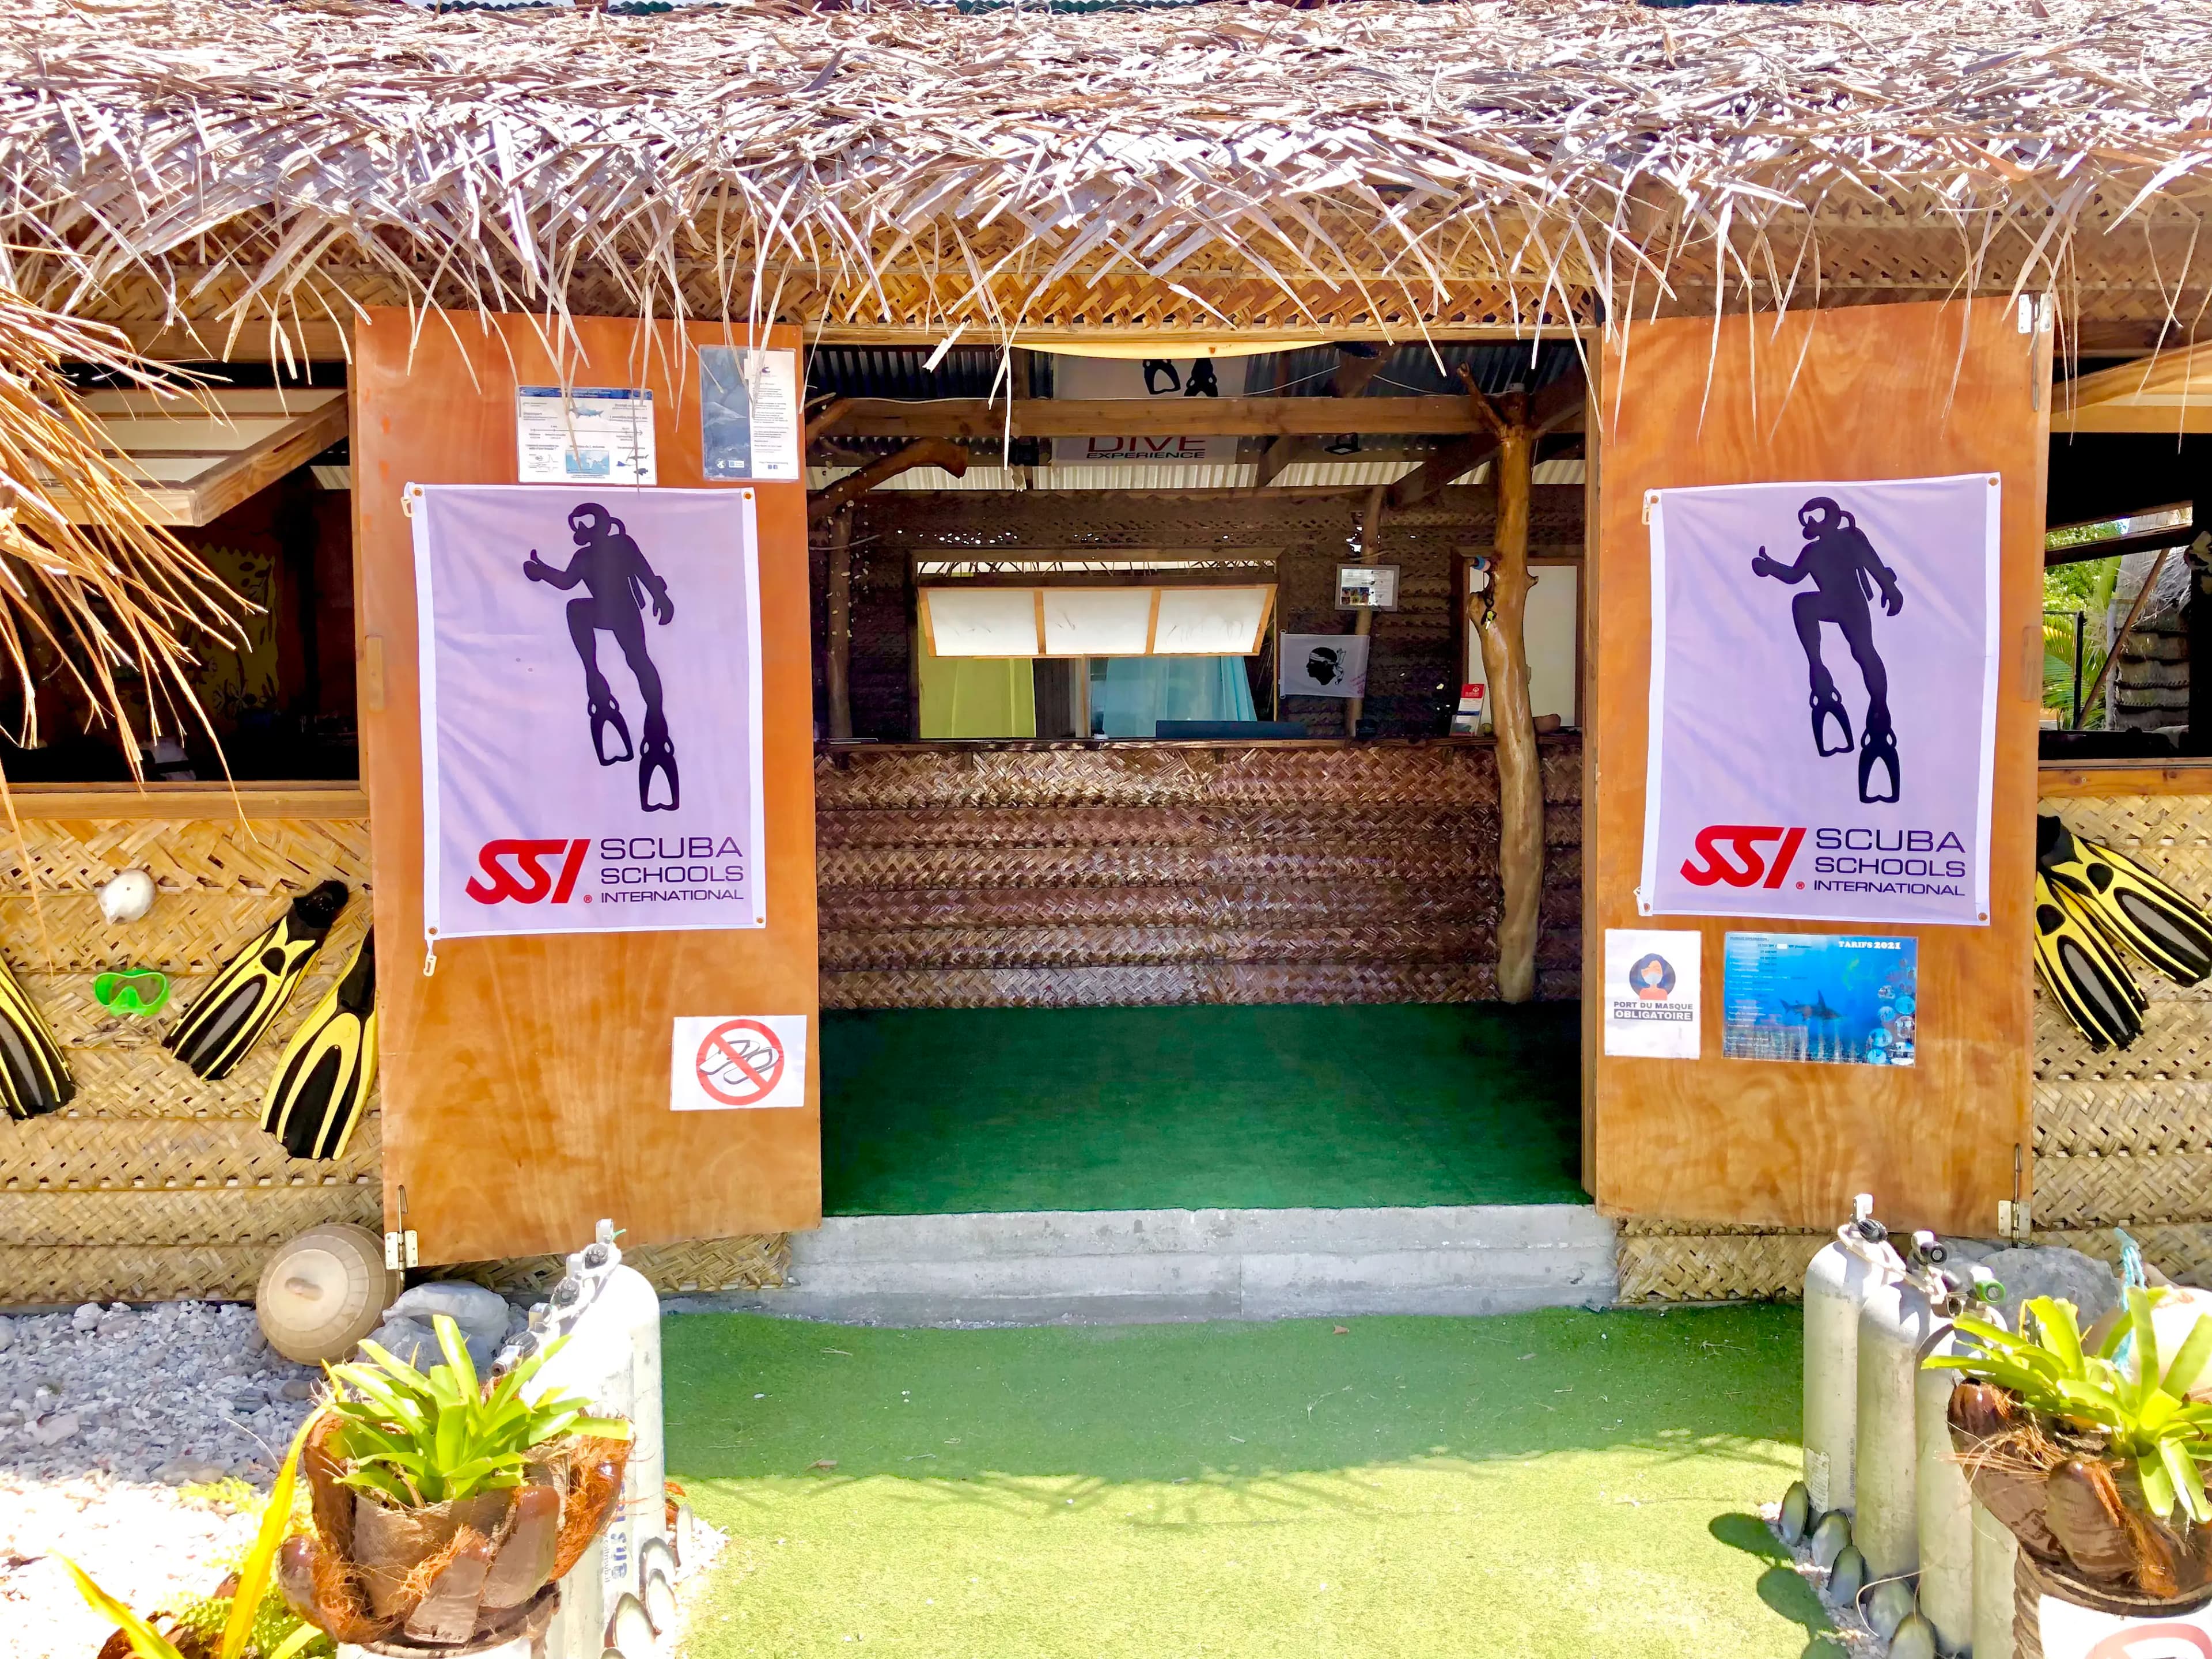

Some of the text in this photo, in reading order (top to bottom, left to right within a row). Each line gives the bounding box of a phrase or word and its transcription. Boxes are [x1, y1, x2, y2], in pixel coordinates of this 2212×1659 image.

[1088, 437, 1206, 452] DIVE
[600, 836, 744, 859] SCUBA
[1816, 828, 1965, 853] SCUBA
[1680, 825, 1807, 888] SSI
[465, 839, 591, 905] SSI
[601, 866, 744, 884] SCHOOLS
[1815, 857, 1965, 877] SCHOOLS
[601, 889, 744, 903] INTERNATIONAL
[1814, 880, 1965, 896] INTERNATIONAL
[1839, 941, 1902, 950] TARIFS 2021
[1615, 1010, 1692, 1021] OBLIGATOIRE
